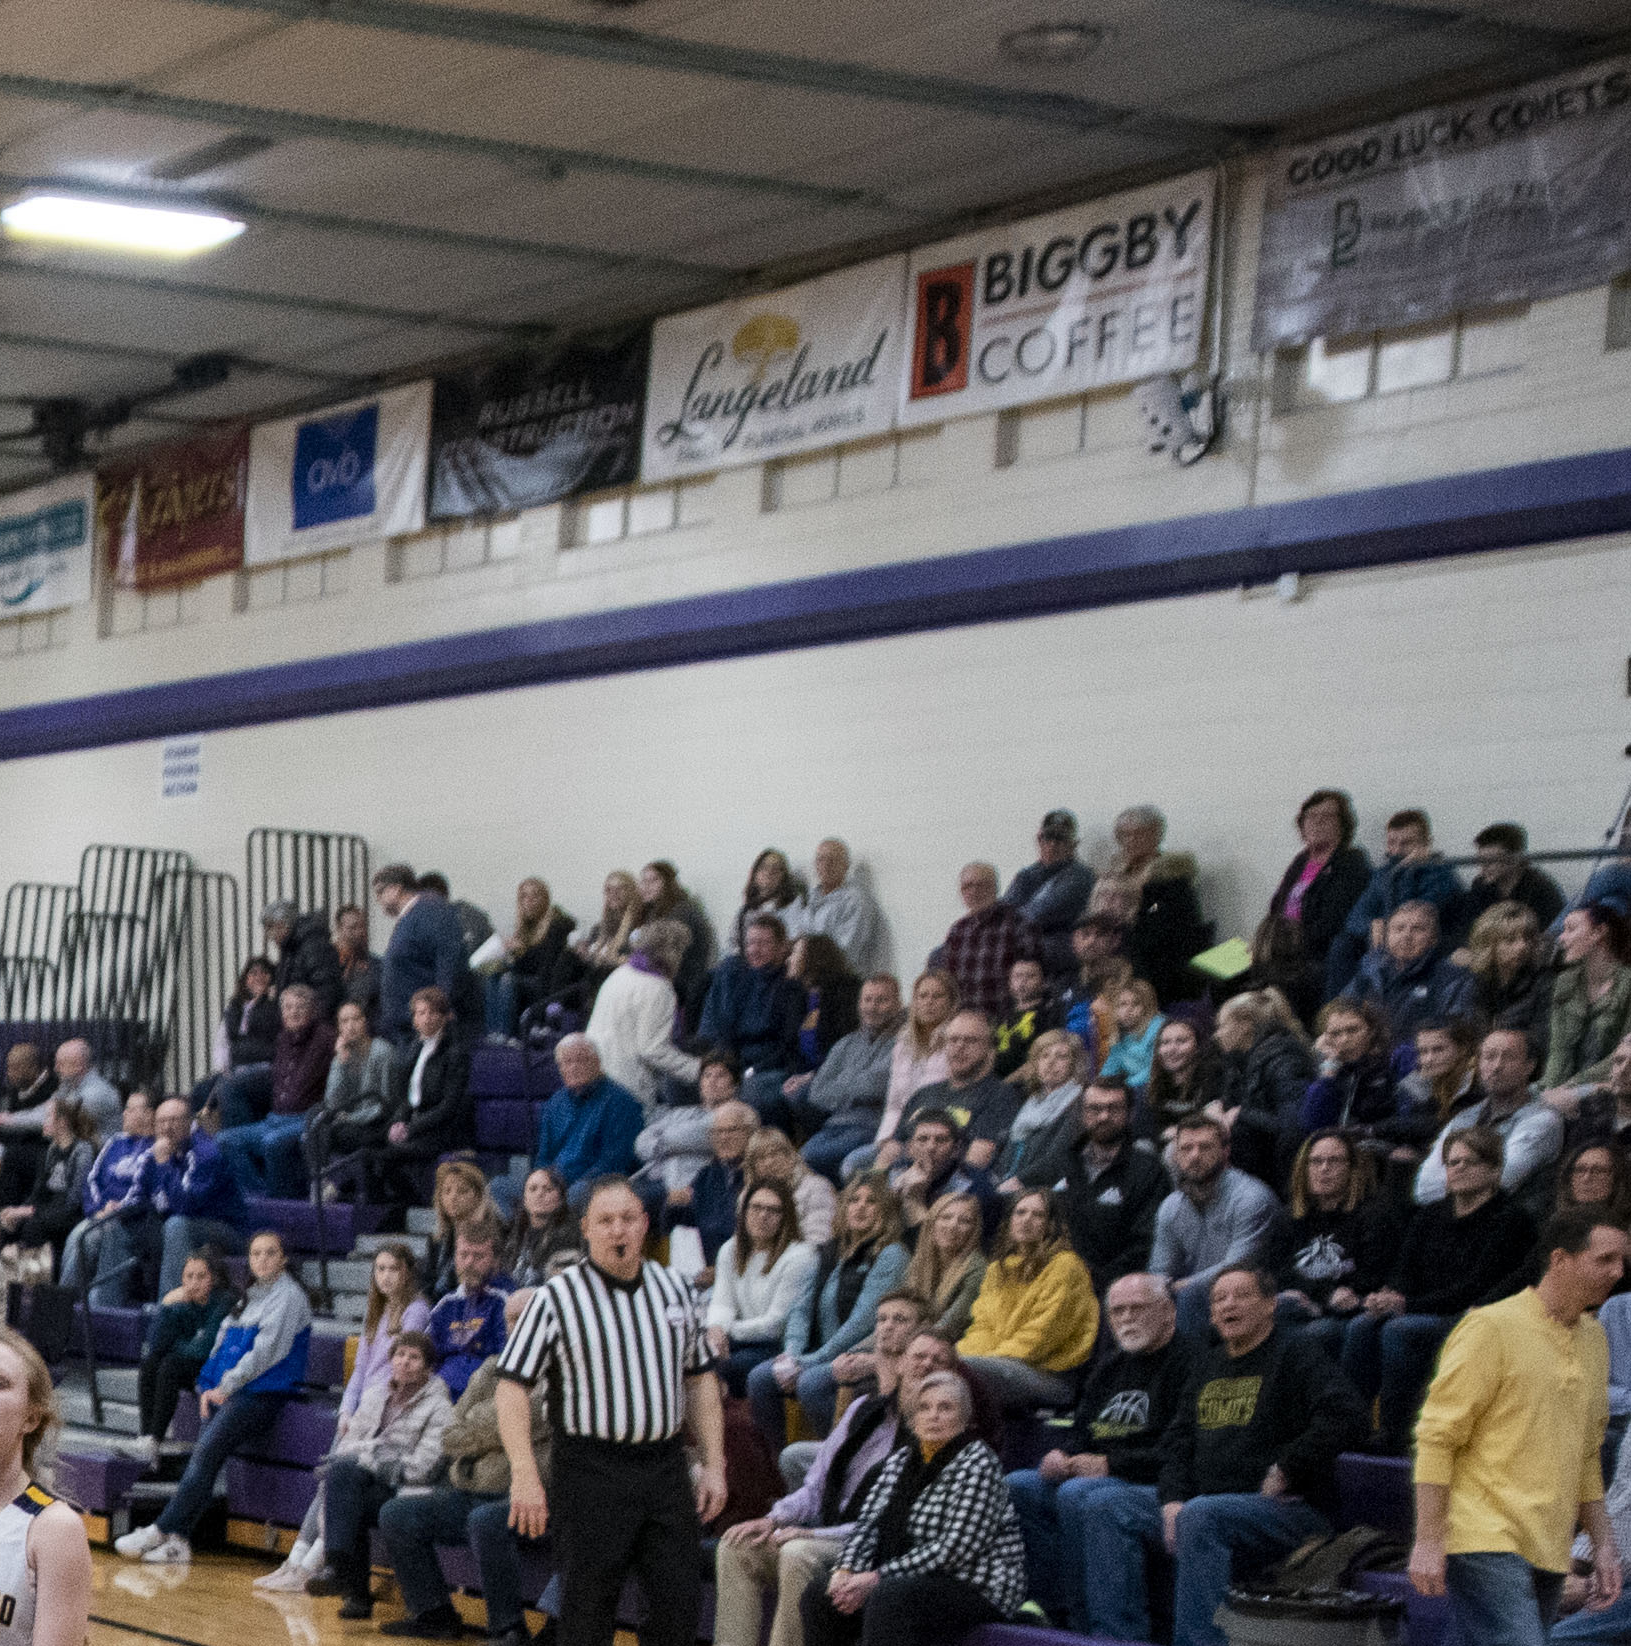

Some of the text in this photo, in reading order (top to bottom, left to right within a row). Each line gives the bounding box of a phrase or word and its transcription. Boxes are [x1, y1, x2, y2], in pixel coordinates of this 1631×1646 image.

[1288, 71, 1630, 185] GOOD LUCK COMETS
[984, 200, 1201, 305] BIGGBY
[655, 326, 889, 452] Langeland
[978, 293, 1195, 384] COFFEE
